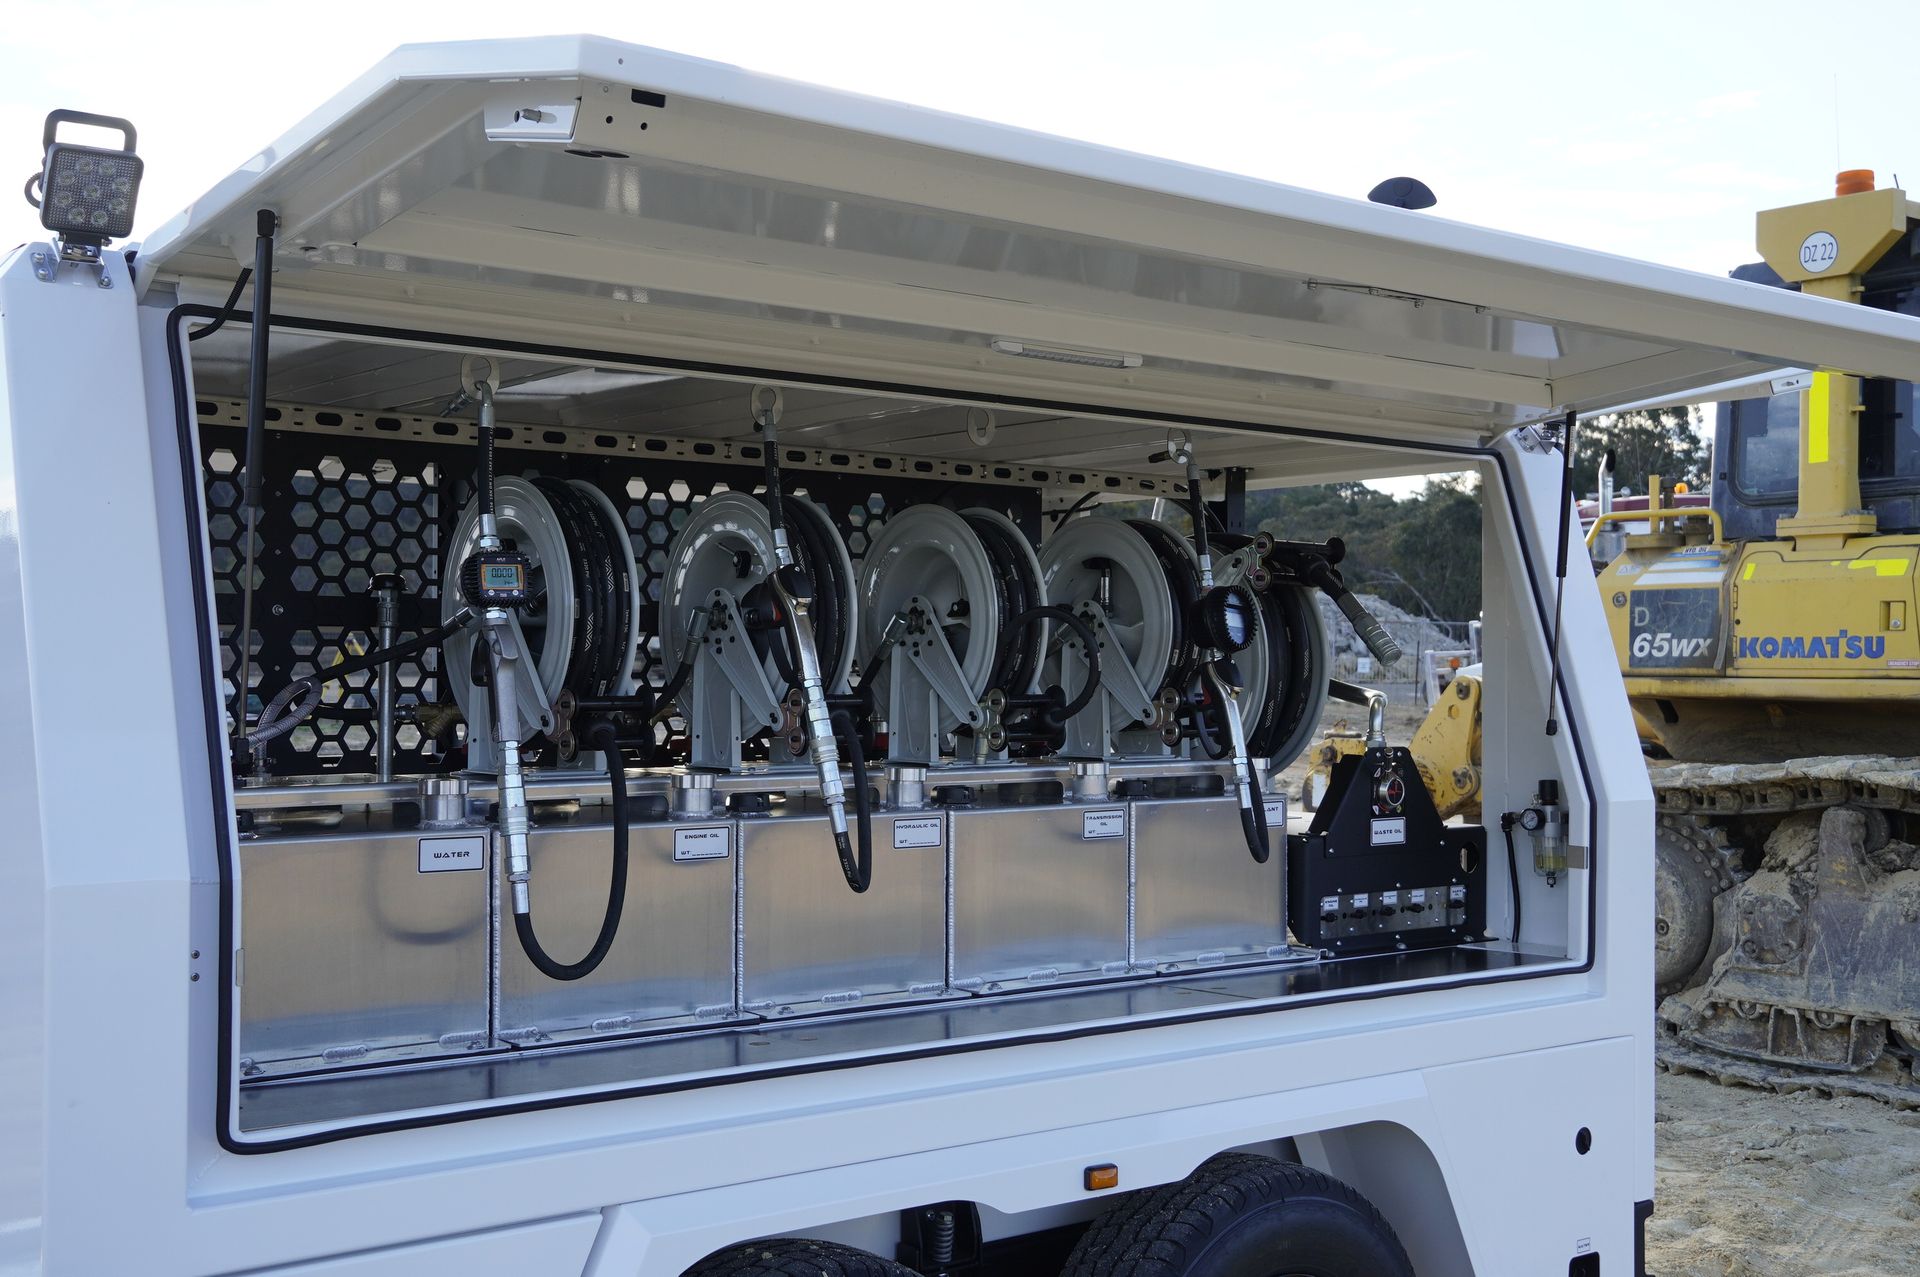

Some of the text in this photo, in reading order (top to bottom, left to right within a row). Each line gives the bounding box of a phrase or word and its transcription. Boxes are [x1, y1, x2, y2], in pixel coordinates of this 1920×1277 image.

[1803, 242, 1834, 263] DZ 22
[1634, 606, 1650, 627] D
[1739, 630, 1885, 659] KOMATSU
[433, 851, 470, 859] WATER
